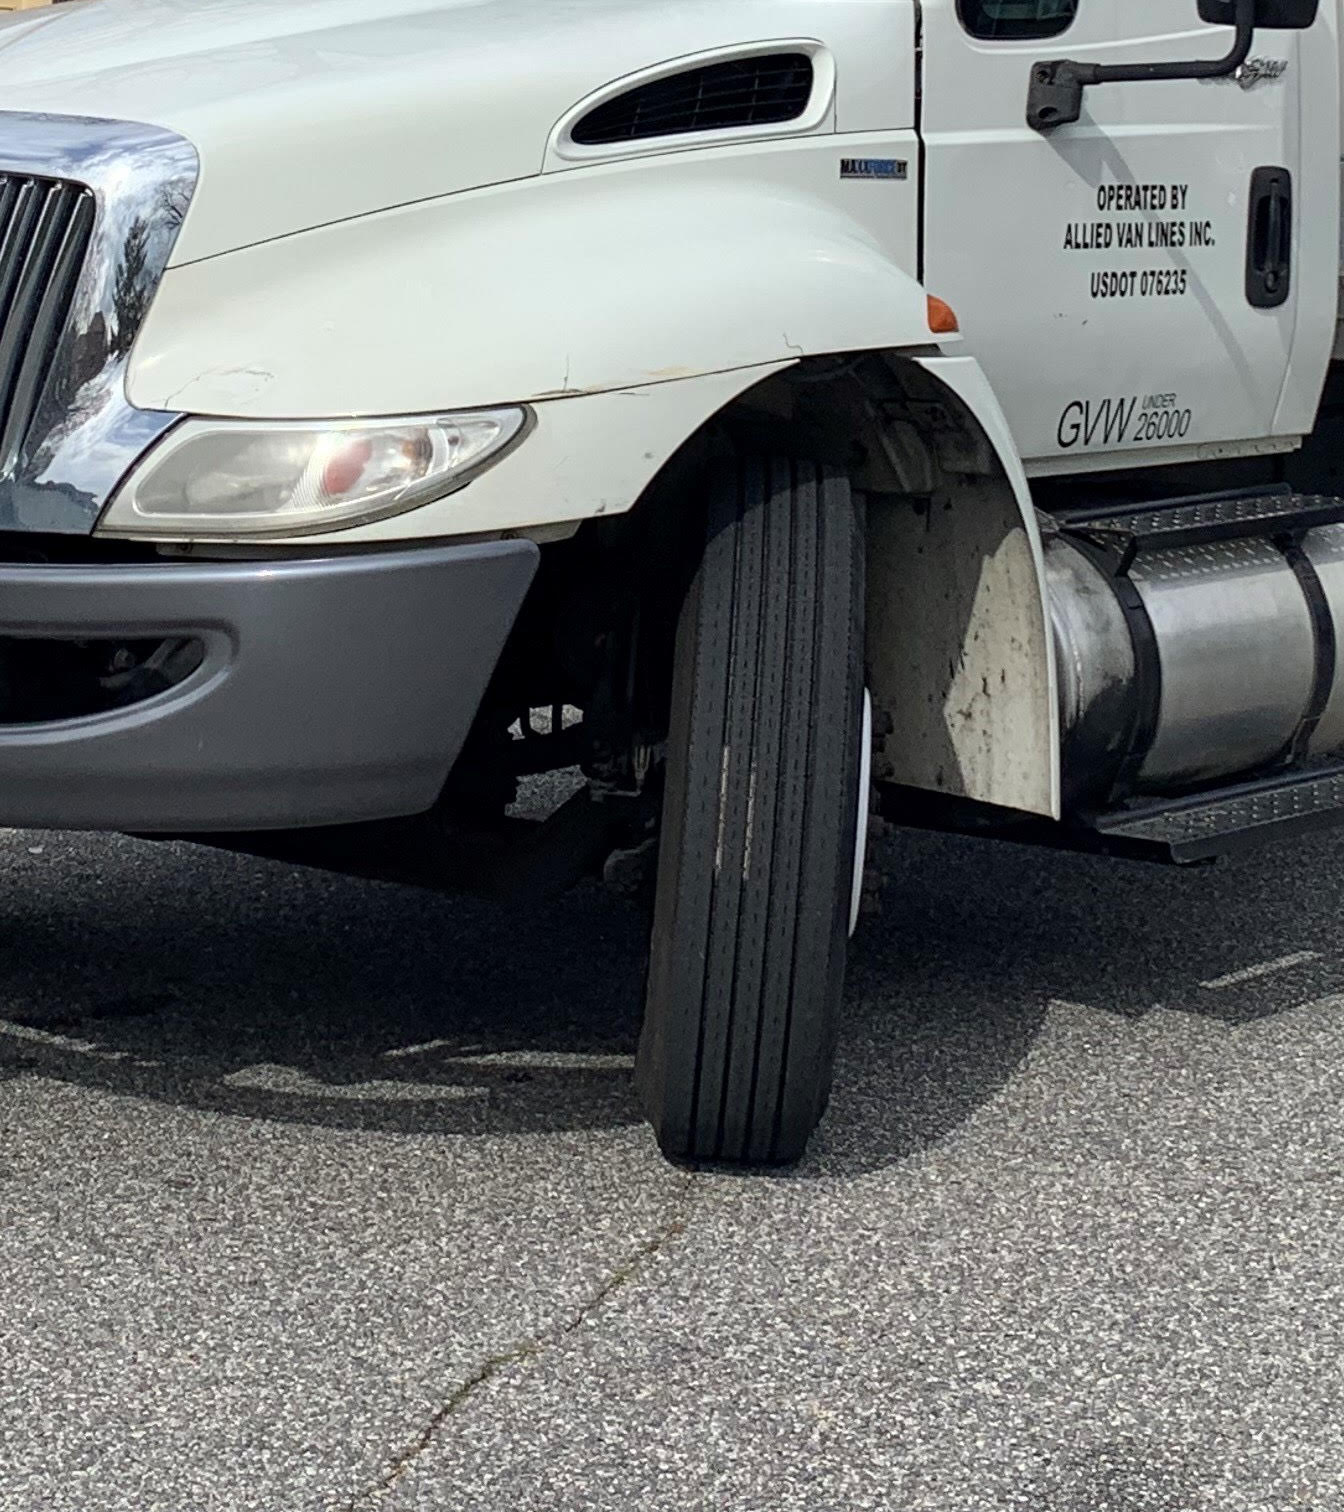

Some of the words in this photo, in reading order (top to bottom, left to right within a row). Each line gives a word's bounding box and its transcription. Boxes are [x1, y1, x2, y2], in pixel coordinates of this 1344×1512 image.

[1097, 185, 1167, 211] OPERATED
[1171, 185, 1188, 210] BY
[1063, 223, 1113, 249] ALLIED
[1117, 222, 1144, 248] VAN
[1148, 221, 1185, 248] LINES
[1189, 220, 1215, 247] INC.
[1090, 271, 1137, 299] USDOT
[1140, 269, 1187, 296] 076235
[1057, 396, 1137, 448] GVW
[1133, 408, 1192, 441] 26000
